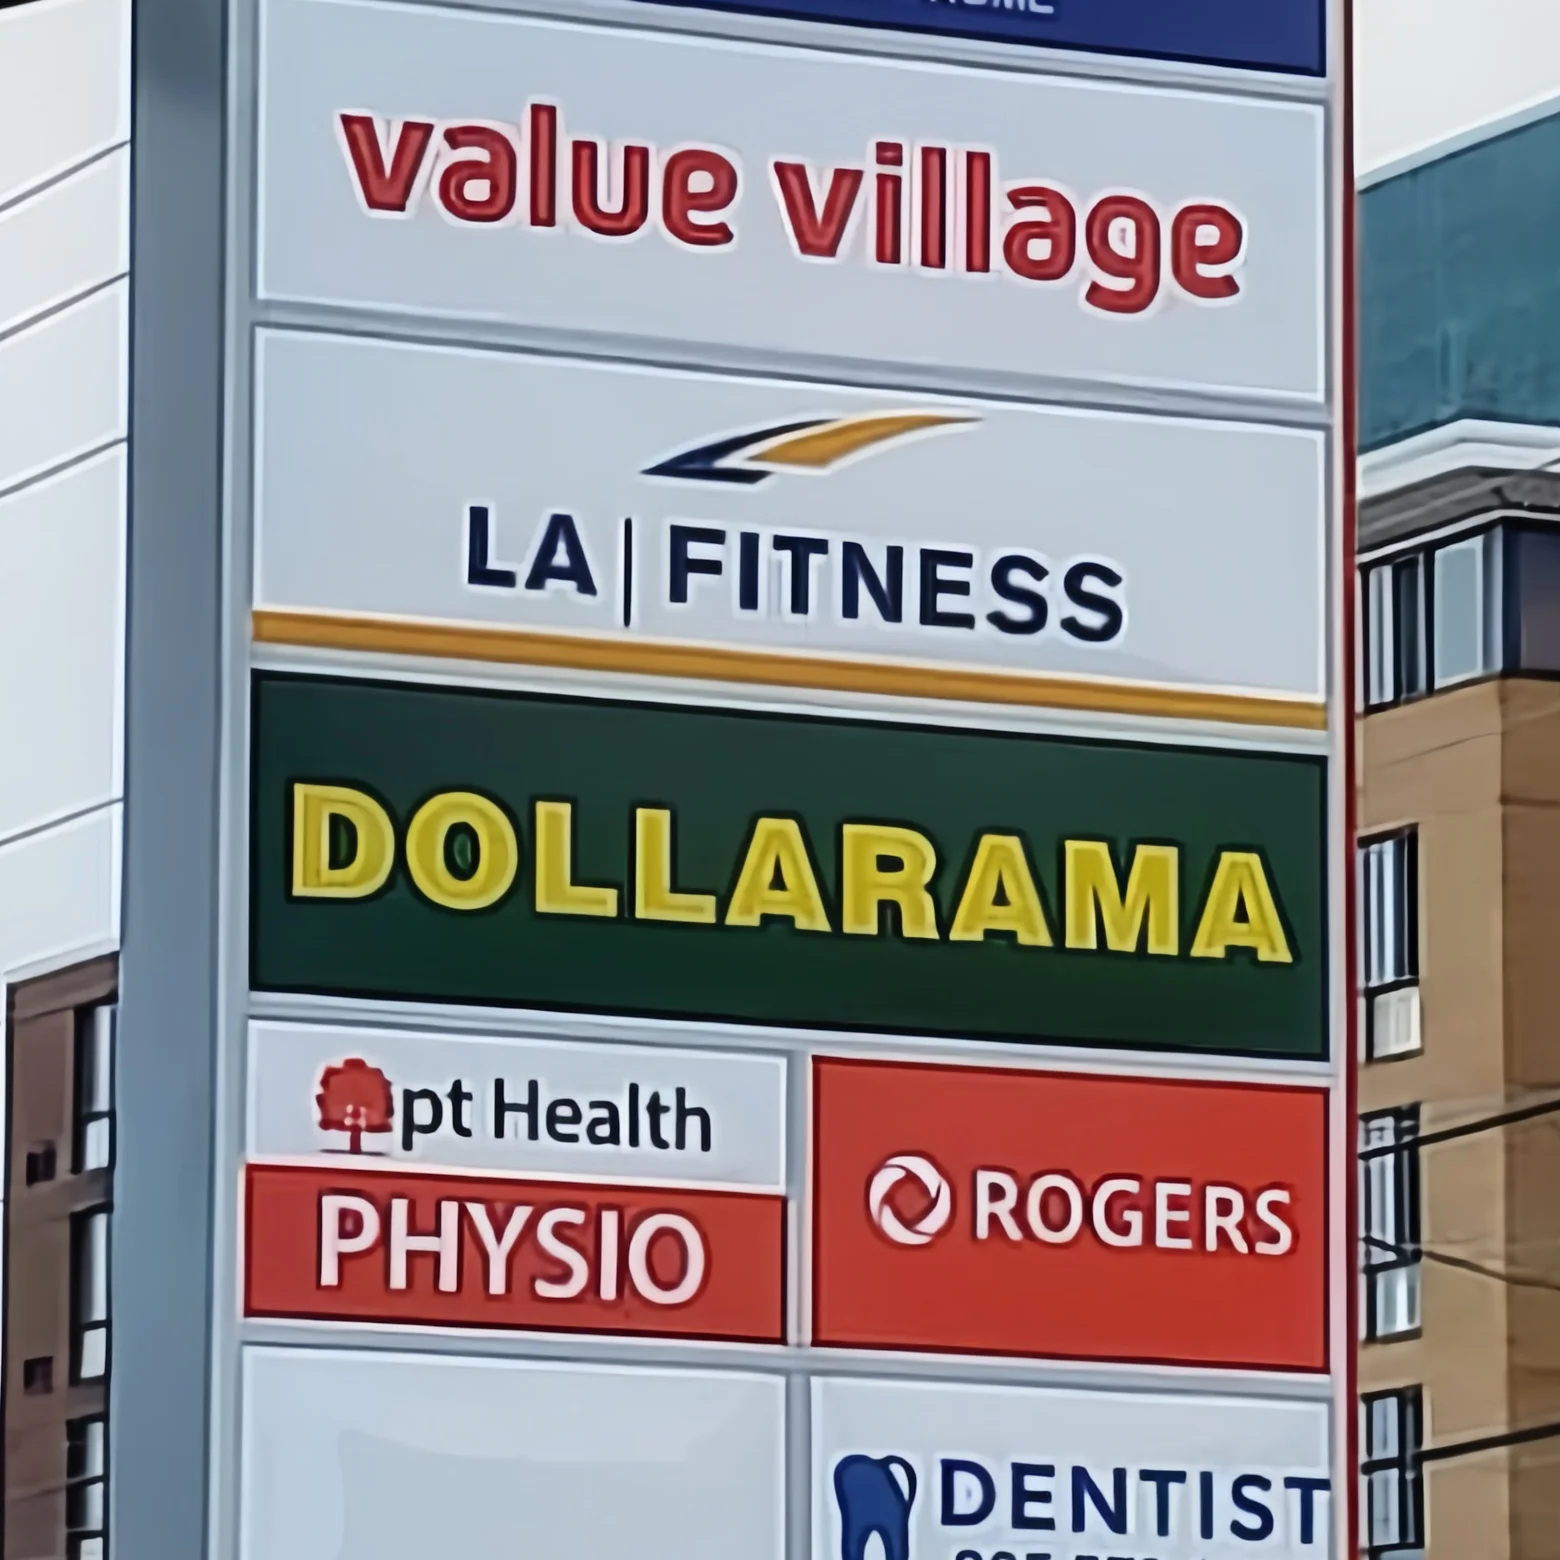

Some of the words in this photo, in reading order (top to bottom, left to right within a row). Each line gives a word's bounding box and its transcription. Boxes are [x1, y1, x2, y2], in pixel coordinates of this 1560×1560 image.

[340, 104, 739, 247] value
[775, 142, 1243, 314] village
[466, 505, 598, 596] LA
[669, 524, 1125, 643] FITNESS
[292, 781, 1295, 965] DOLLARAMA
[402, 1077, 472, 1154] pt
[492, 1075, 713, 1154] Health
[319, 1191, 707, 1307] PHYSIO
[974, 1167, 1294, 1257] ROGERS
[940, 1458, 1332, 1546] DENTIST
